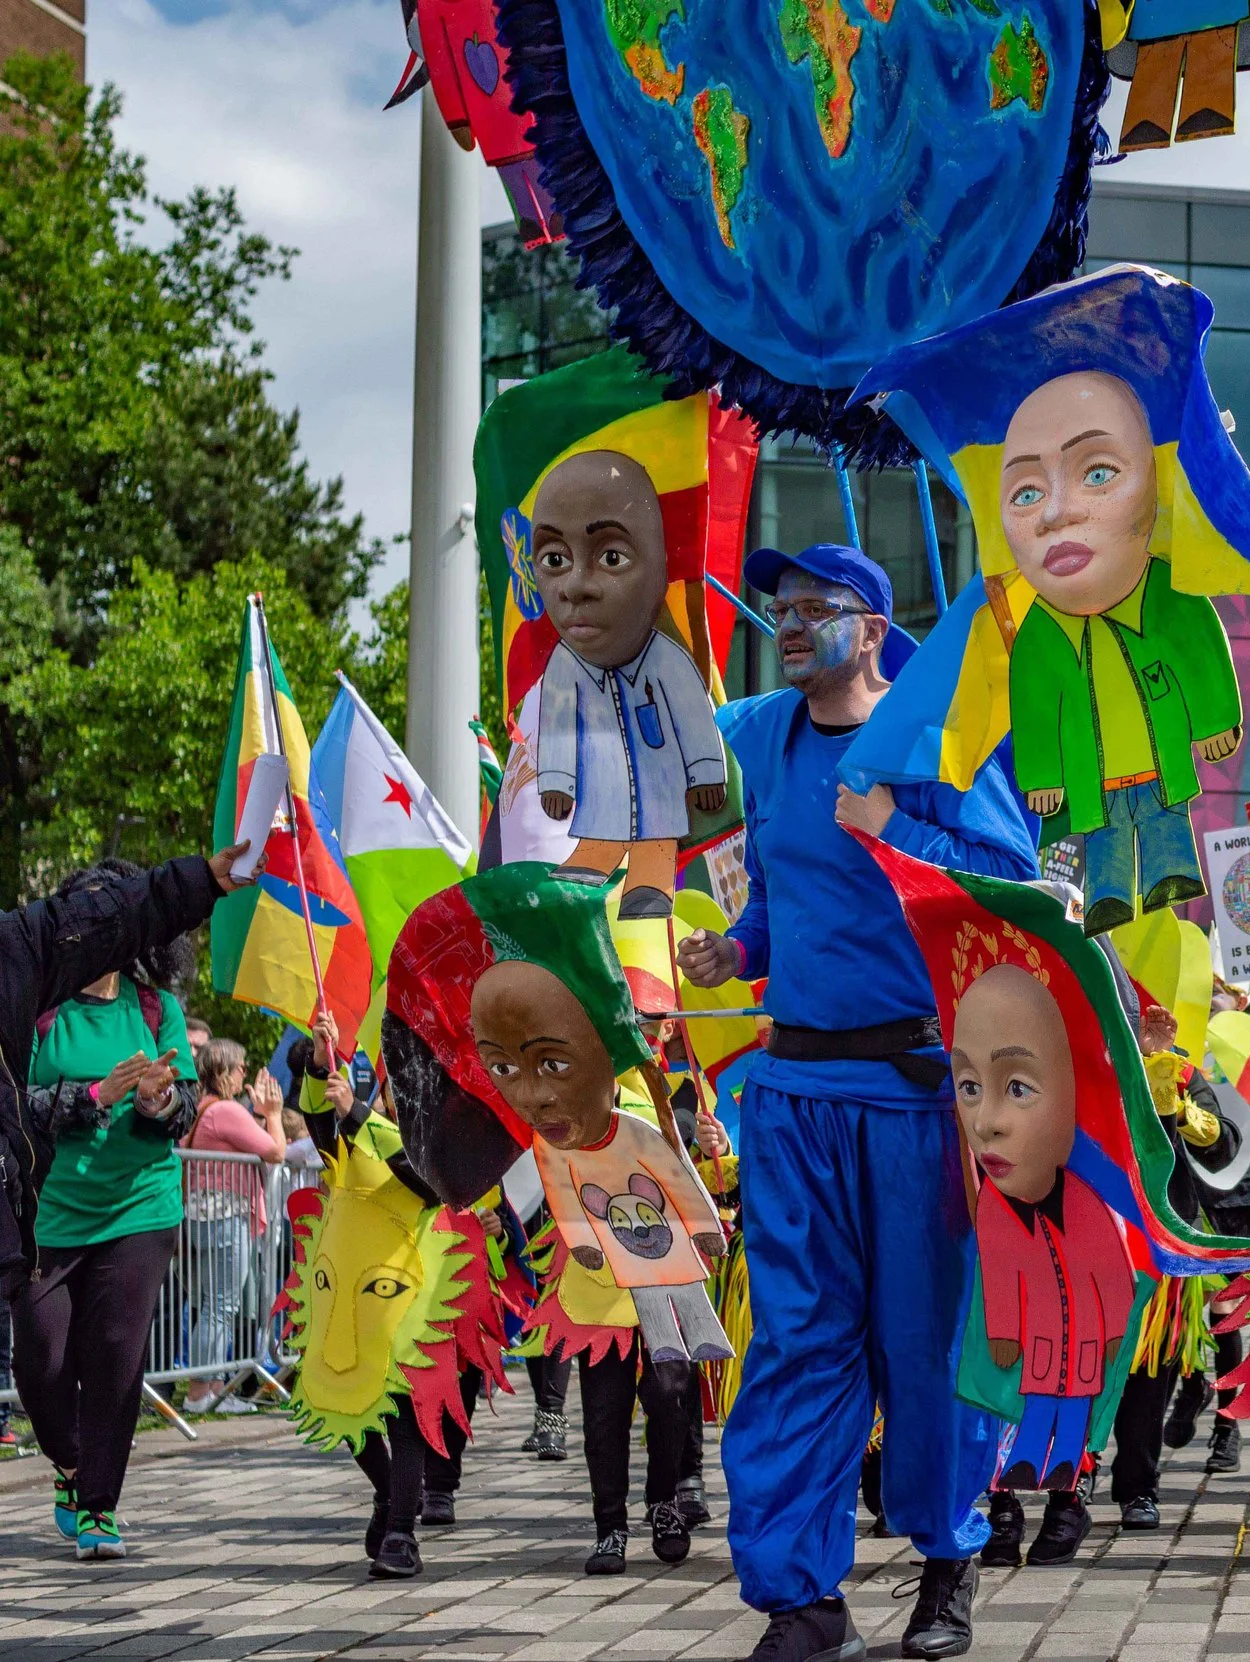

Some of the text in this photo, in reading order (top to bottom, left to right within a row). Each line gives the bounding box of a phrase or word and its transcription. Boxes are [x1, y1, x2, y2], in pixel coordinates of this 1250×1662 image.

[1059, 841, 1077, 855] GET
[1213, 841, 1222, 852] A
[1231, 947, 1242, 958] IS
[1231, 966, 1239, 976] A
